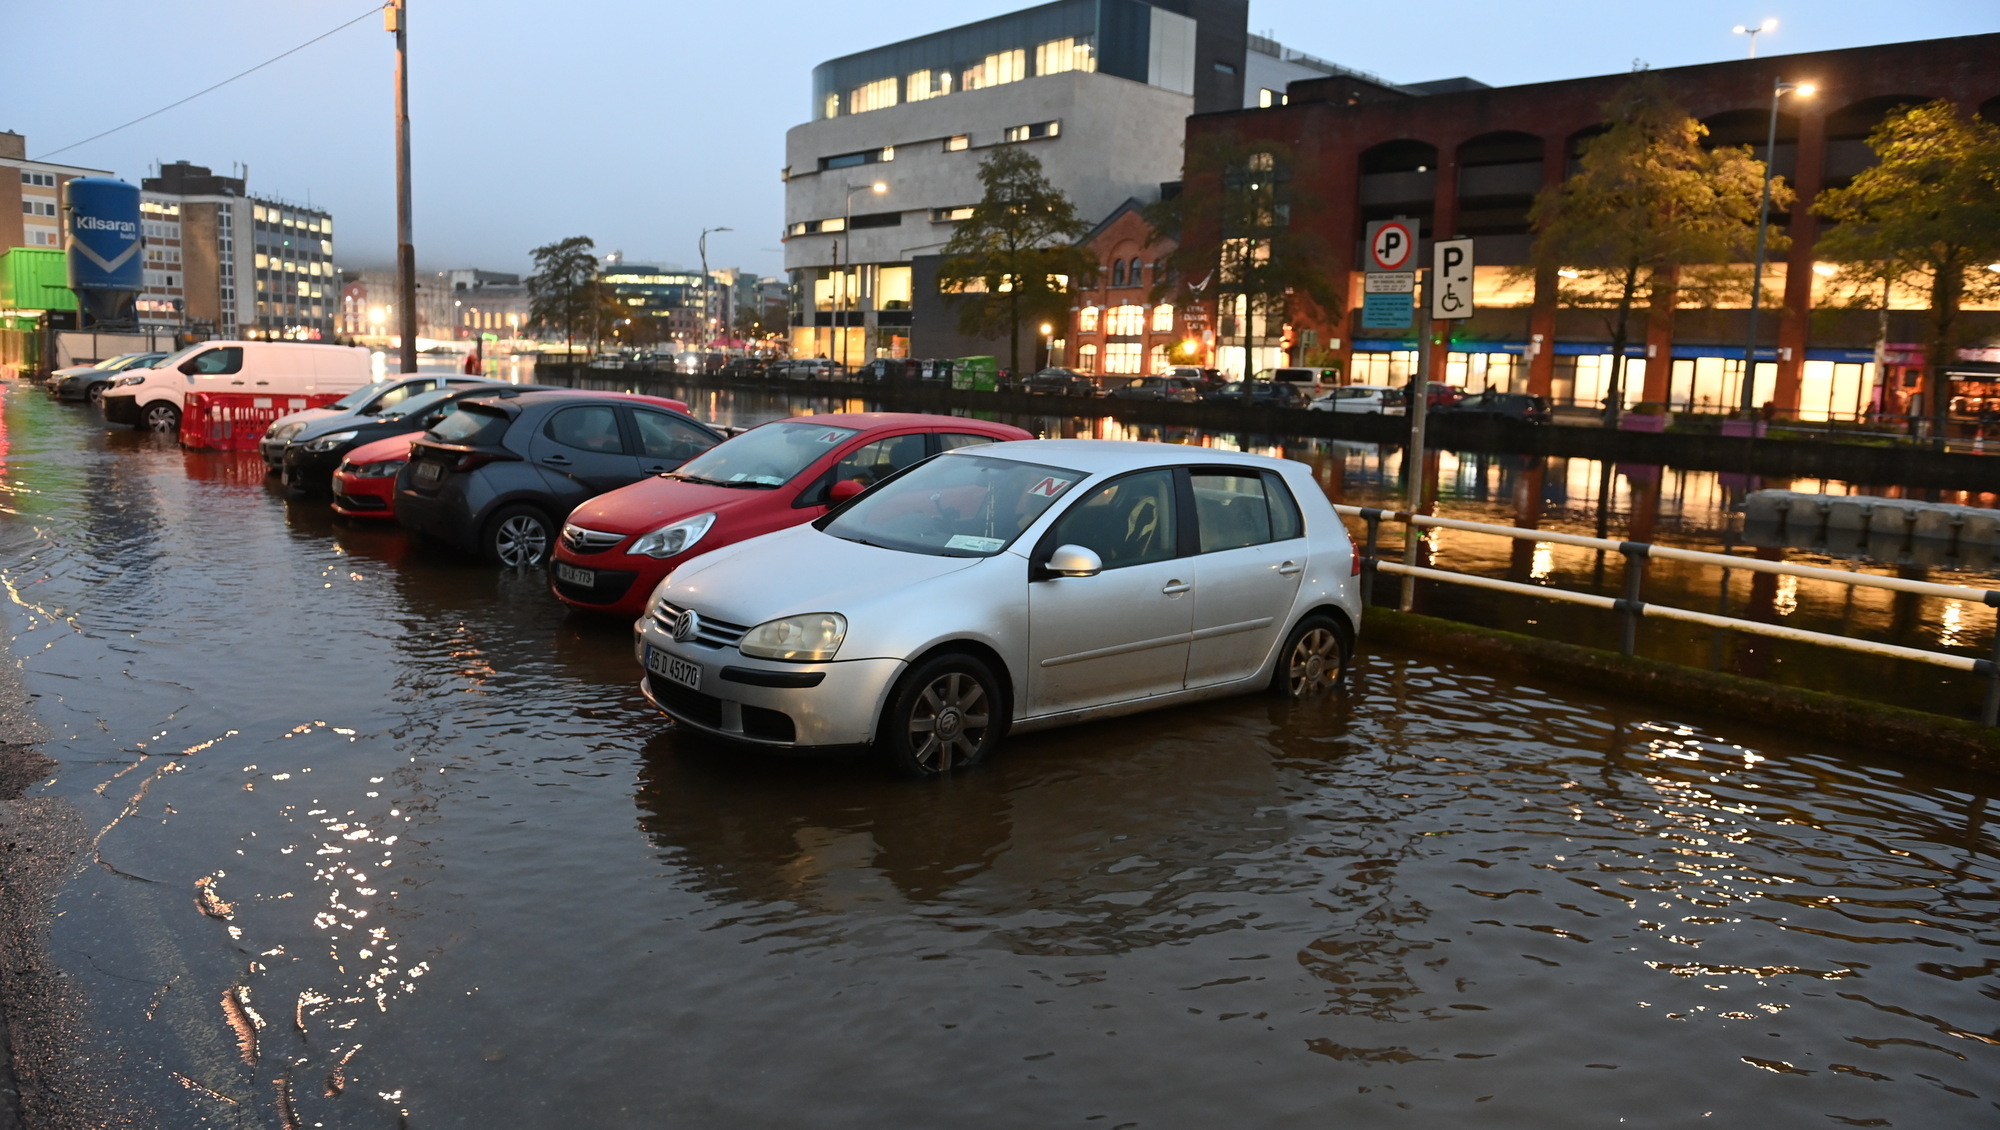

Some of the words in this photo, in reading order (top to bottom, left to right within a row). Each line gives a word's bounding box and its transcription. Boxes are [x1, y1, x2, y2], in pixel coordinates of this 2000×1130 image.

[77, 216, 136, 232] Kilsaran
[1385, 232, 1401, 258] P
[1443, 247, 1463, 277] P
[819, 431, 846, 443] N
[1031, 477, 1068, 496] N
[651, 650, 660, 670] 05
[661, 655, 668, 674] D
[669, 659, 698, 686] 45170
